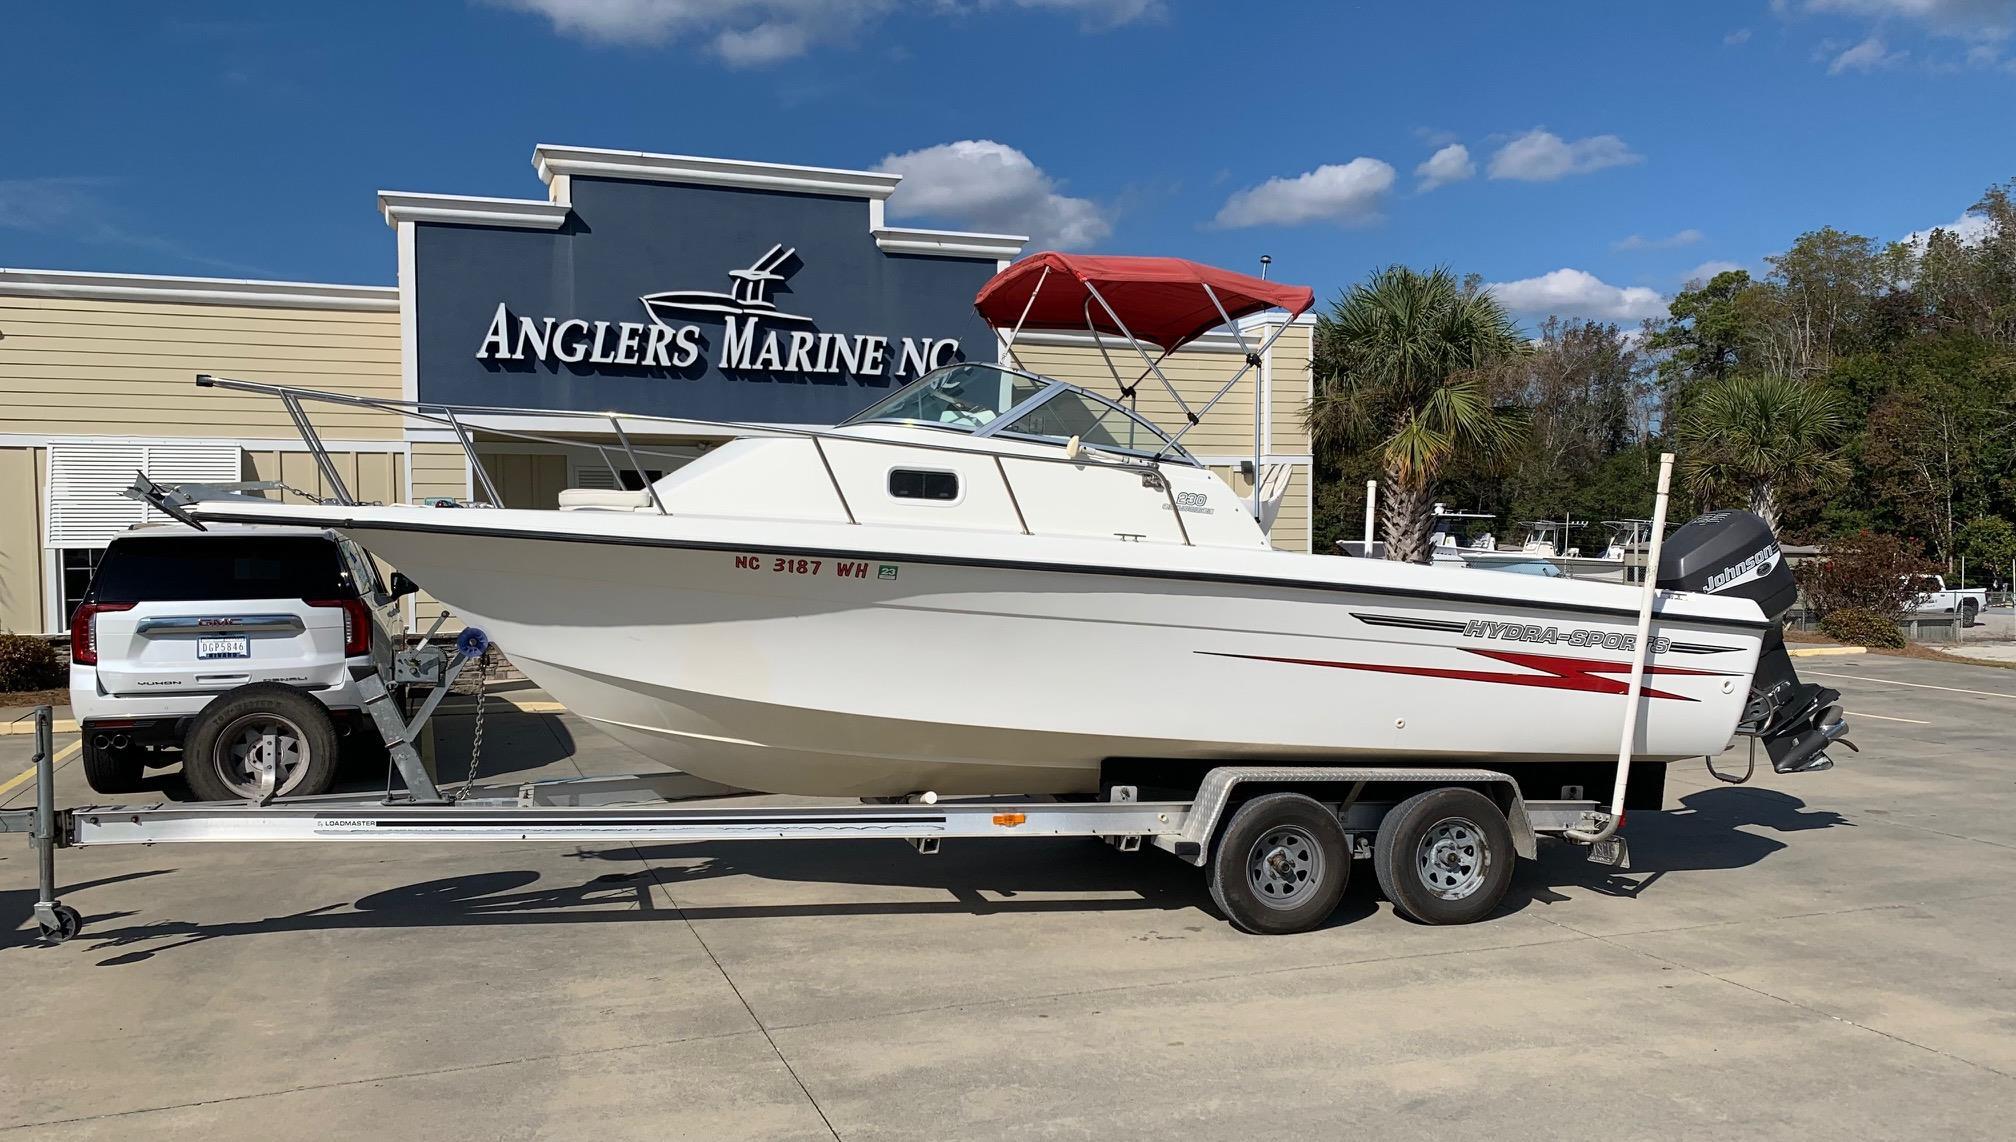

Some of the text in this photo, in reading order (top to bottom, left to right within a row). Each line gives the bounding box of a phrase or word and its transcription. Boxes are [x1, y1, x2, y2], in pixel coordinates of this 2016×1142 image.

[475, 302, 959, 385] ANGLERS MARINE NC
[1176, 492, 1208, 507] 230
[735, 556, 869, 578] NC 3187 WH
[881, 568, 896, 576] 23
[1702, 543, 1774, 593] Johnson
[198, 618, 242, 626] GMC
[202, 642, 244, 652] DGP5846
